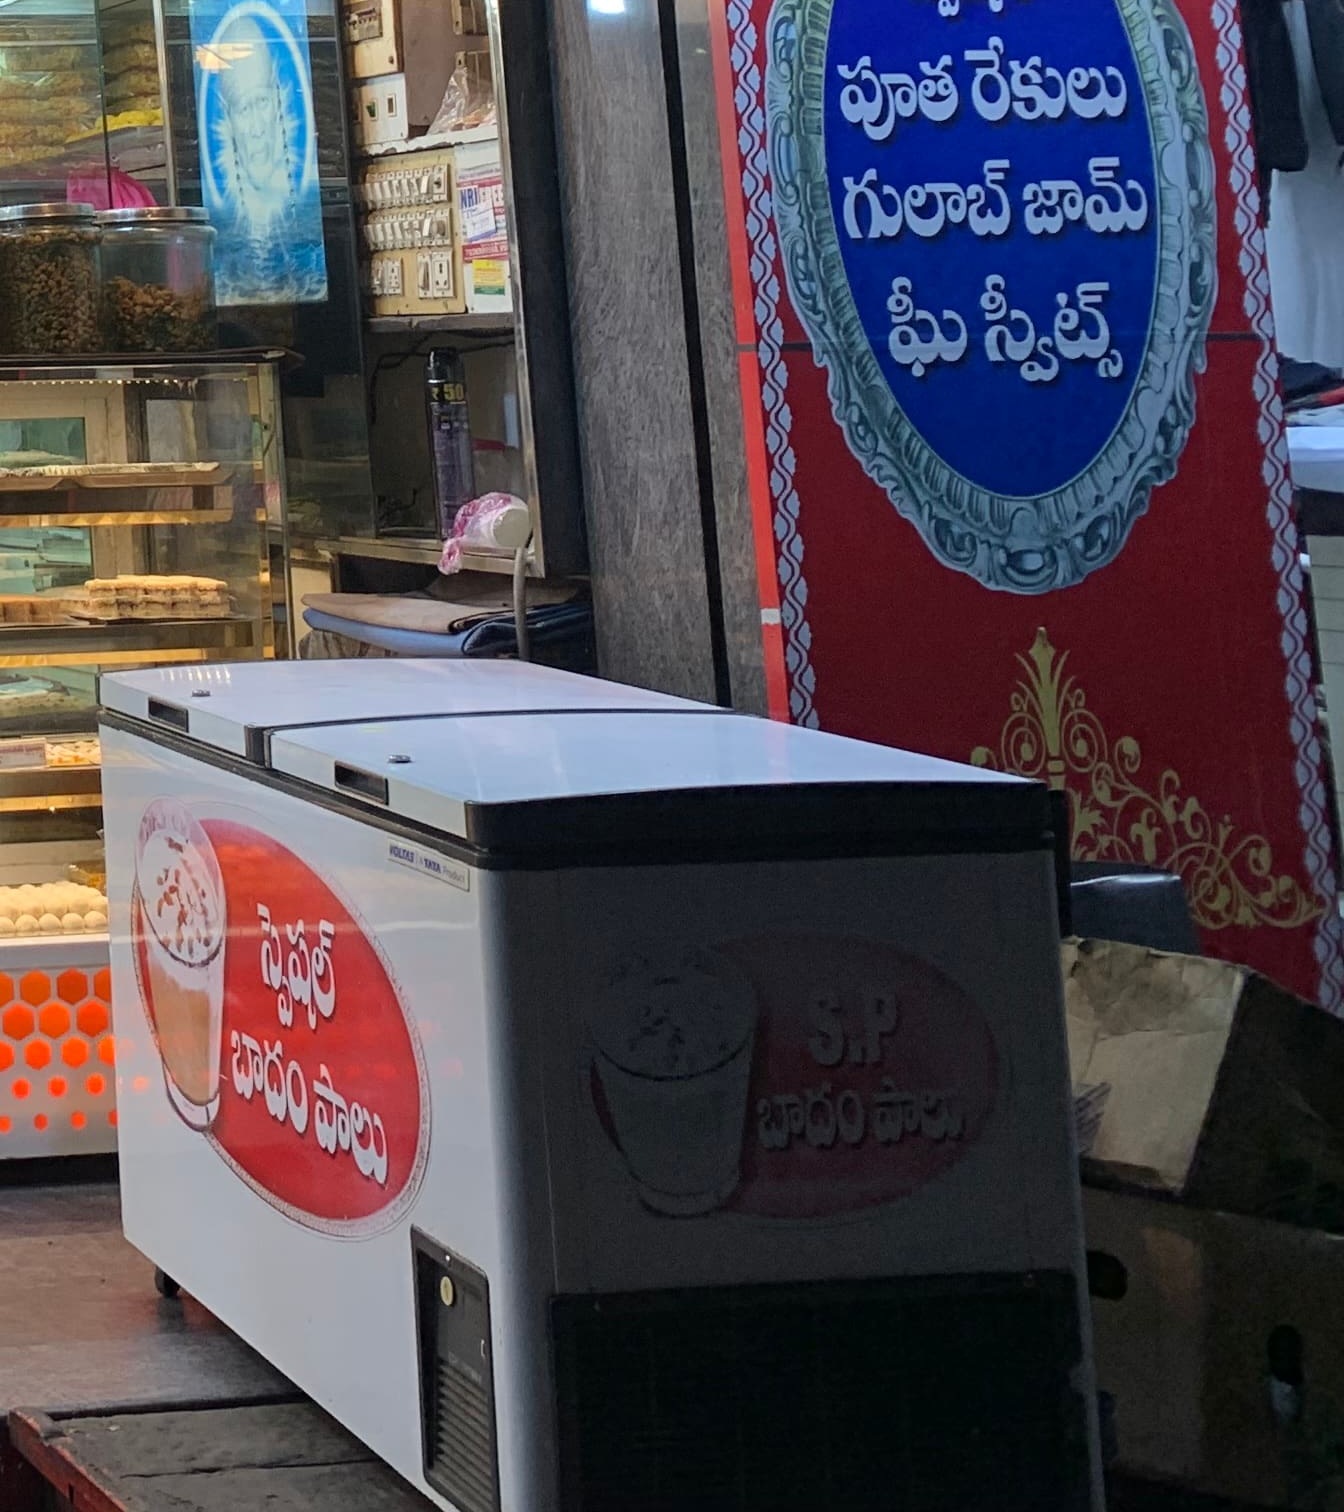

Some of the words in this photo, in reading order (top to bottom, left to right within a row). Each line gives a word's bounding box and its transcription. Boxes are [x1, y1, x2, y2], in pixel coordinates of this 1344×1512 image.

[836, 54, 959, 141] పూత
[964, 36, 1128, 122] రేకులు
[842, 159, 1011, 239] గులాబ్
[1022, 156, 1149, 235] జామ్
[886, 276, 968, 377] ఘీ
[980, 274, 1124, 382] స్వీట్స్
[388, 844, 415, 864] VOLTAS
[424, 857, 442, 874] TATA
[256, 902, 336, 1030] స్పెషల్
[230, 1030, 308, 1134] బాదం
[313, 1063, 388, 1185] పాలు
[756, 1078, 867, 1151] బాదం
